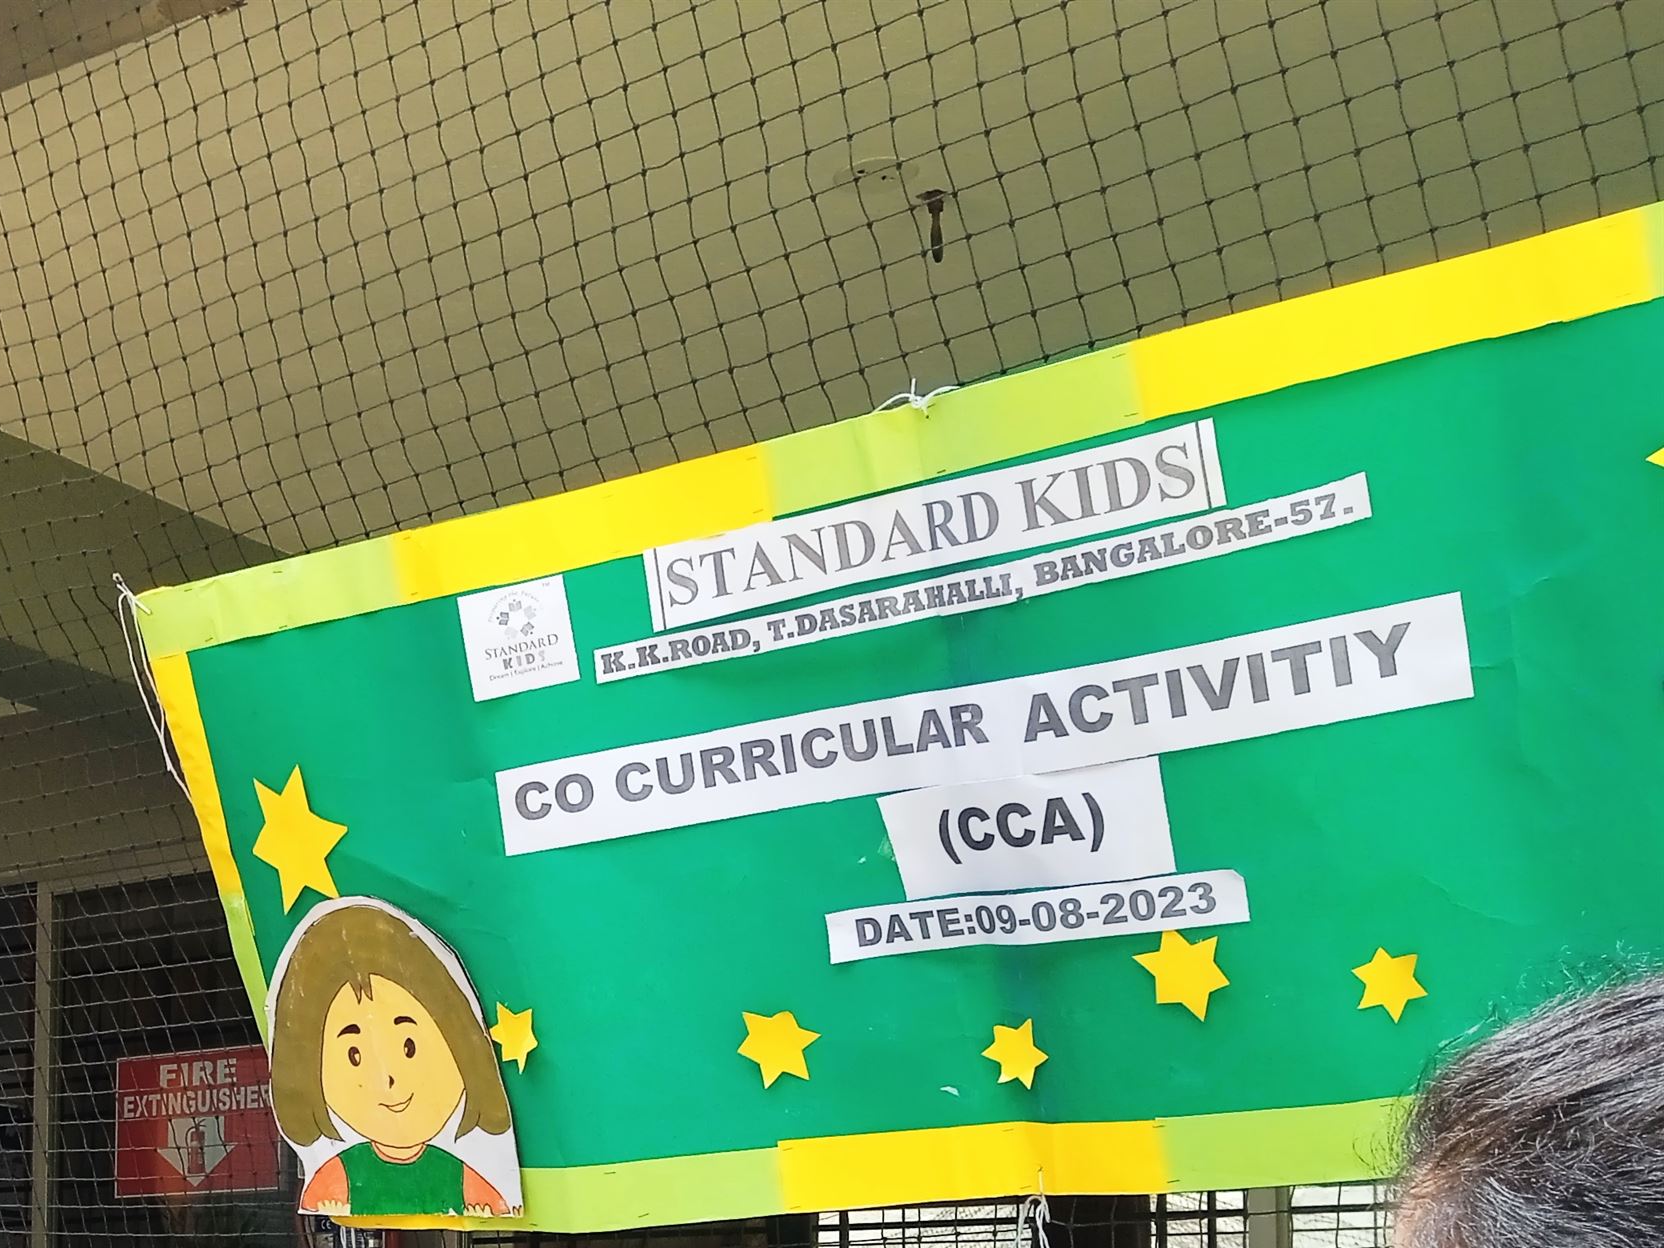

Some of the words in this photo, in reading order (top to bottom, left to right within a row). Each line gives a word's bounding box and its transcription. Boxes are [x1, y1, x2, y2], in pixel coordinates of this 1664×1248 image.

[665, 491, 999, 608] STANDARD
[1014, 441, 1196, 533] KIDS
[600, 629, 761, 676] K.K.ROAD,
[767, 573, 1024, 642] T.DASARAHALLI,
[1033, 493, 1355, 587] BANGALORE-57.
[484, 633, 559, 661] STANDARD
[502, 650, 546, 671] KIDS
[514, 773, 595, 821] CO
[615, 702, 990, 803] CURRICULAR
[1023, 621, 1412, 744] ACTIVITIY
[938, 791, 1105, 865] (CCA)
[854, 881, 1218, 949] DATE:09-08-2023
[159, 1058, 237, 1089] FIRE
